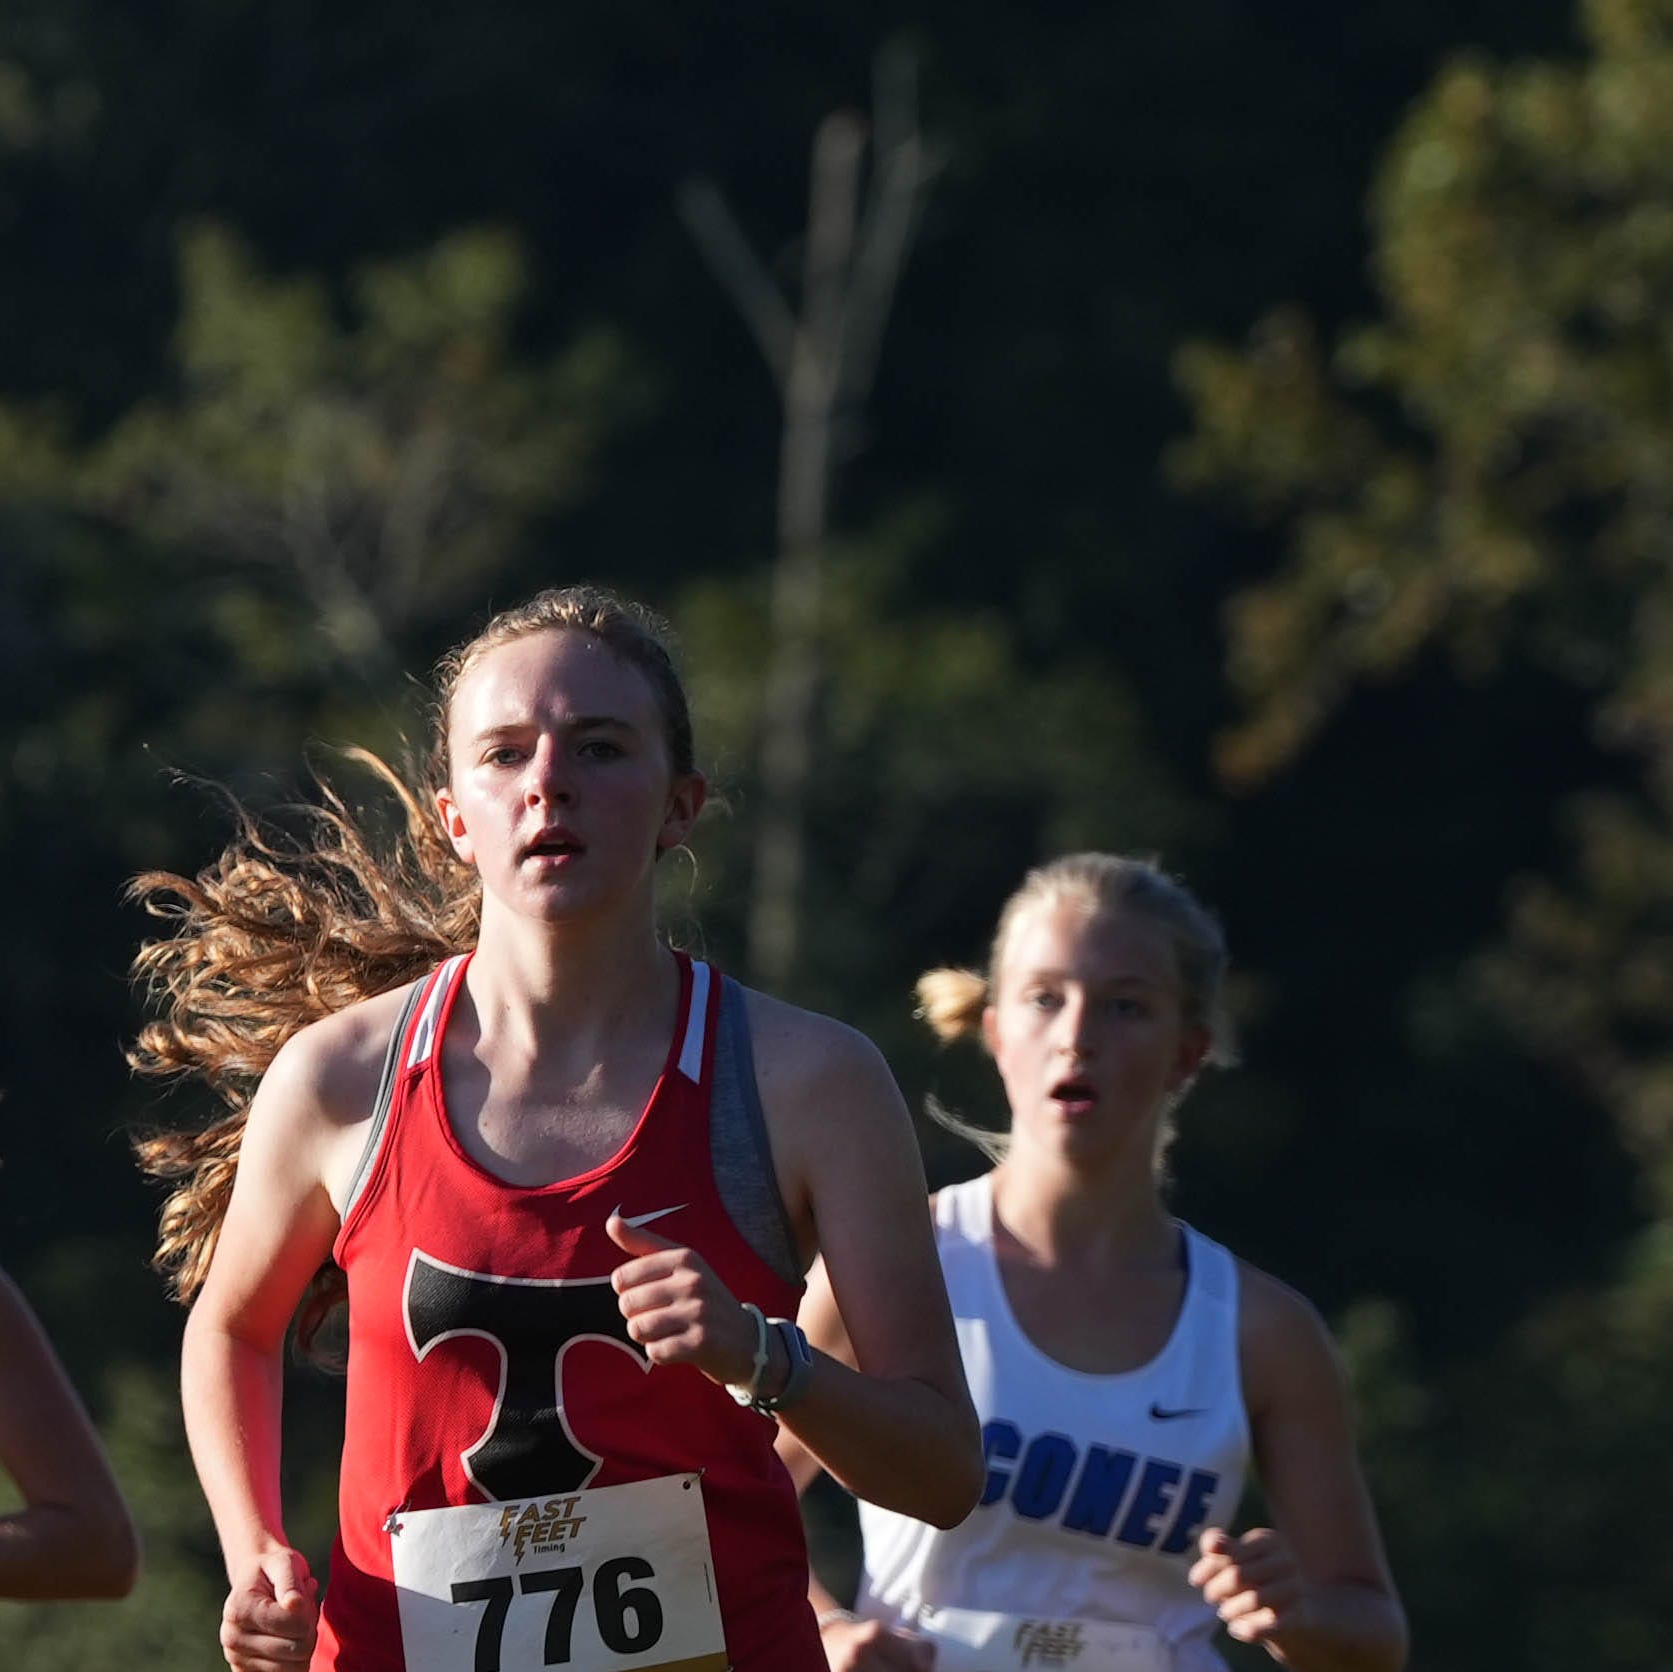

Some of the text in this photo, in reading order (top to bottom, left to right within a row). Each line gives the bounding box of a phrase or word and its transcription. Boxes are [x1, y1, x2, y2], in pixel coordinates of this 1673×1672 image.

[401, 1246, 658, 1503] T
[979, 1416, 1222, 1554] CONEE
[499, 1495, 582, 1529] FAST
[513, 1516, 587, 1549] FEET
[533, 1542, 566, 1554] Timing
